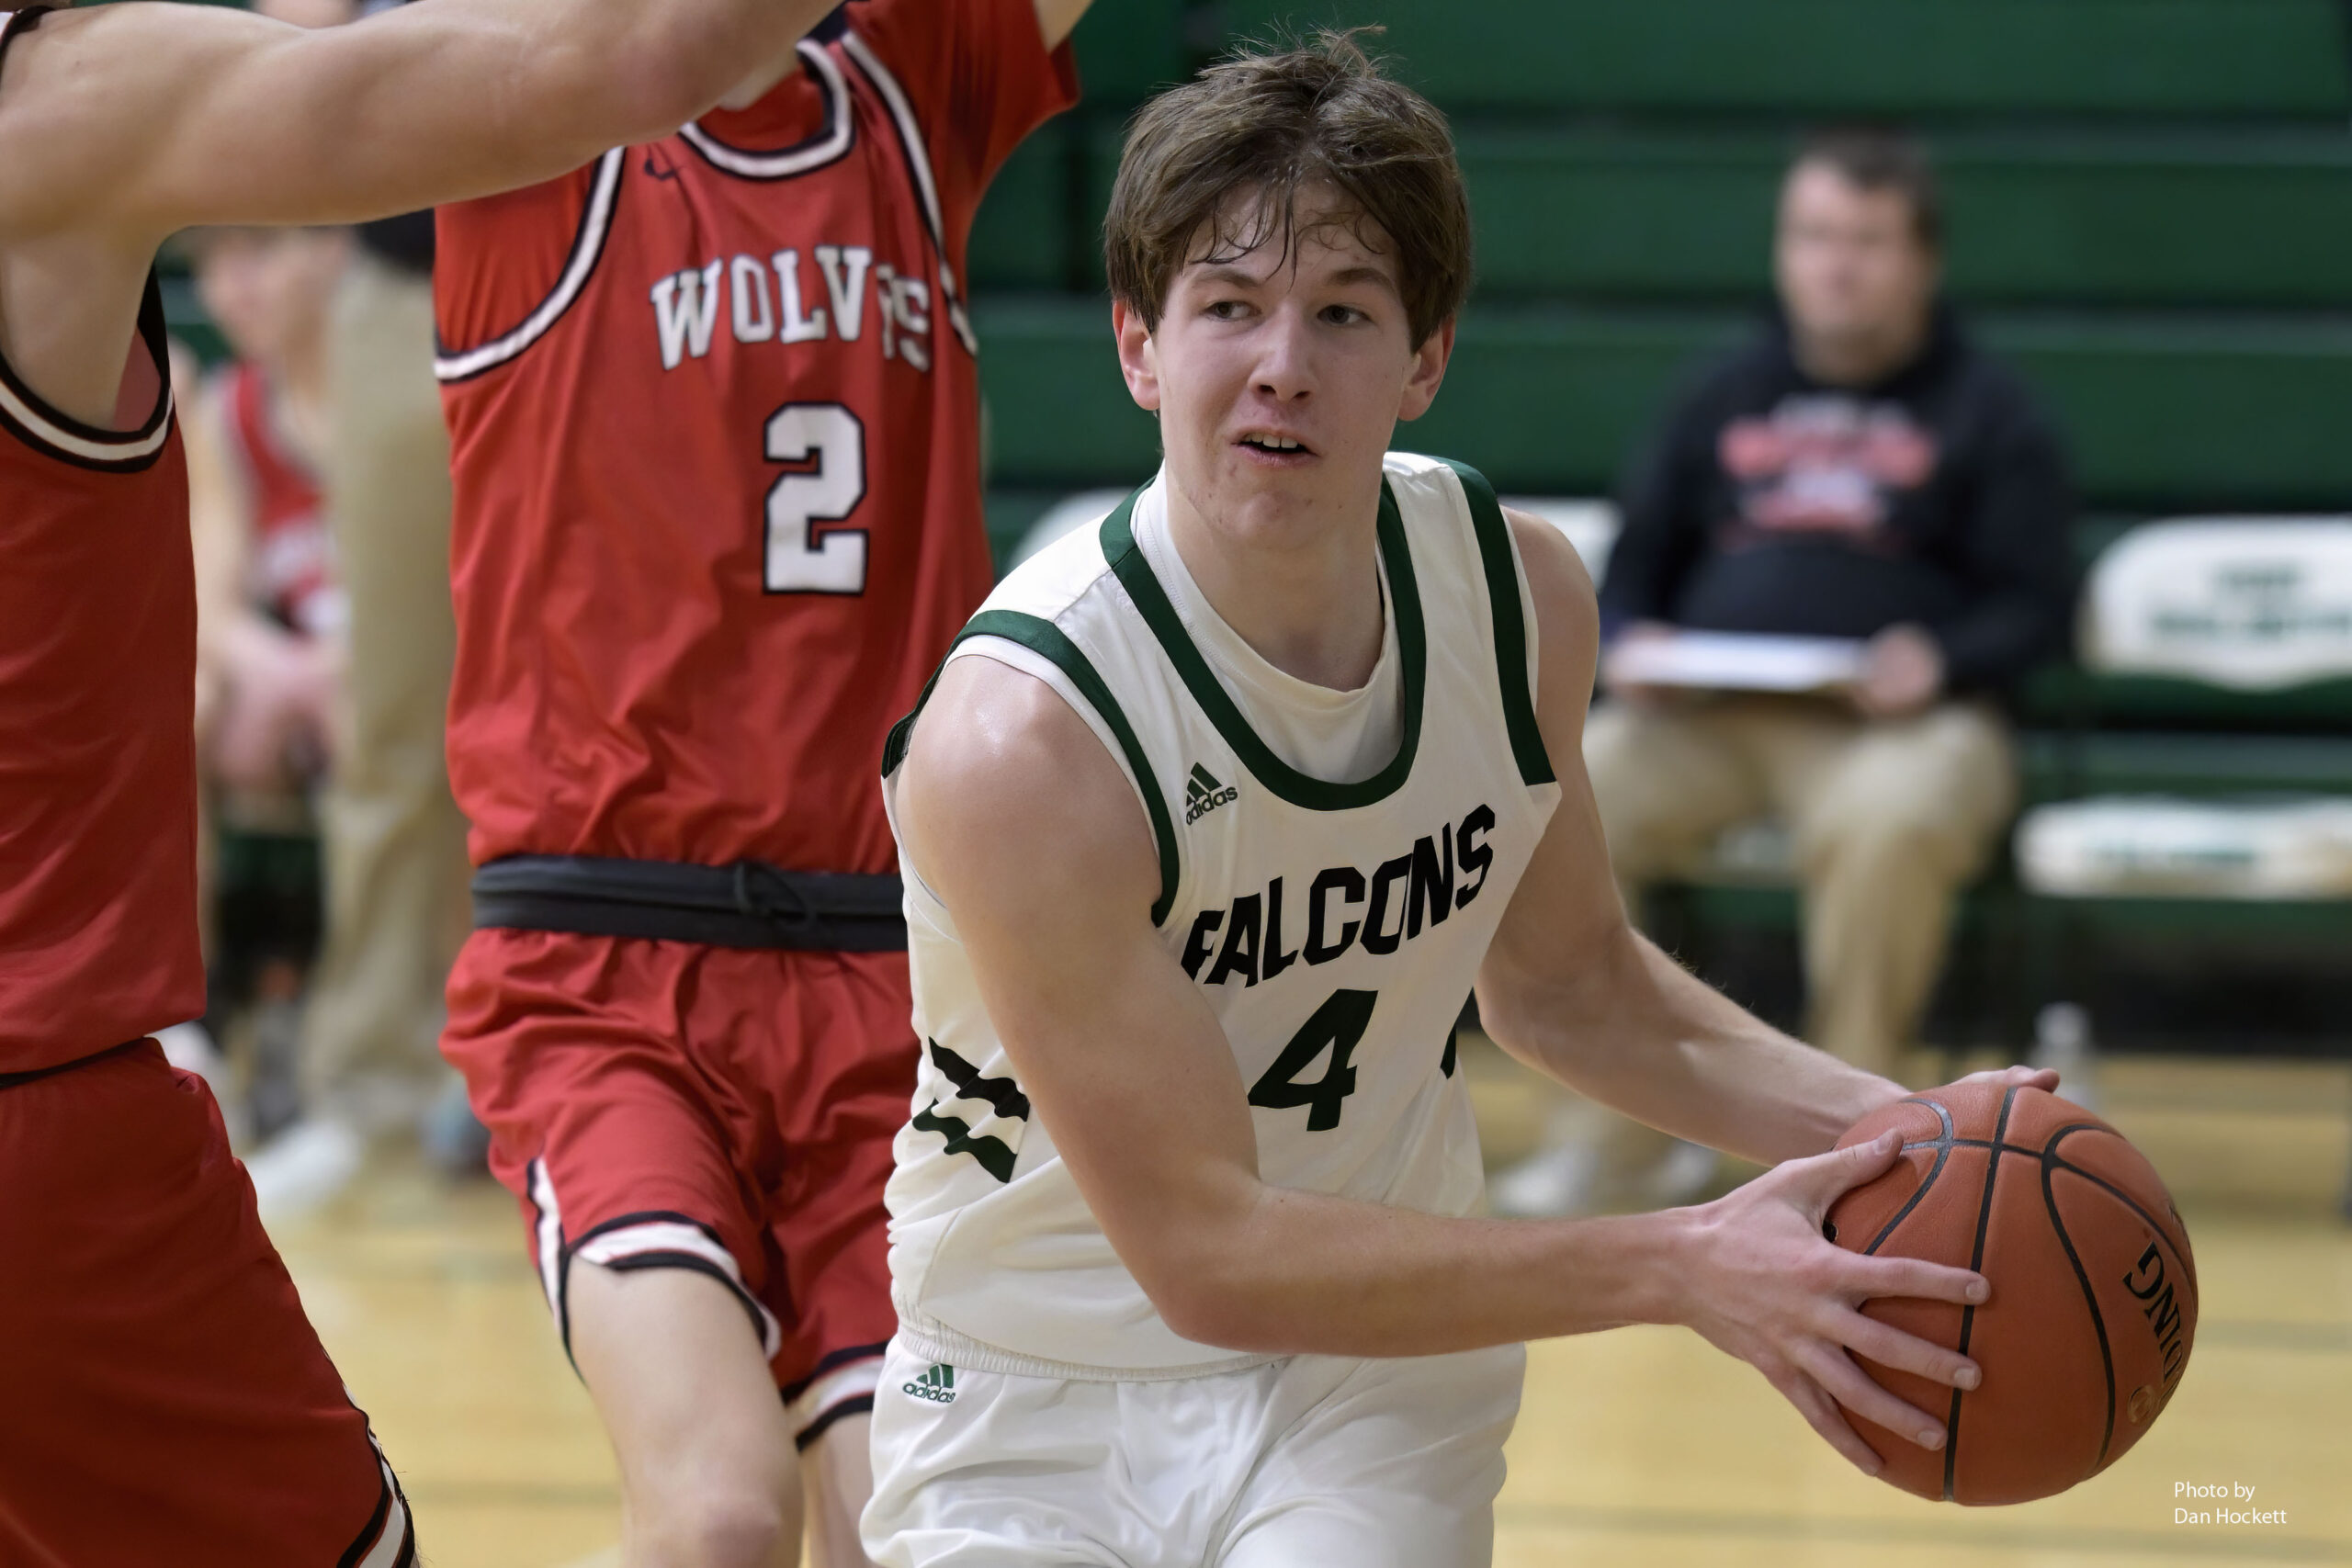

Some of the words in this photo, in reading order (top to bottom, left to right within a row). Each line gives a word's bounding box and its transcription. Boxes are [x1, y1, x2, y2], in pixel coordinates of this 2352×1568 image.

[763, 401, 868, 595] 2
[1186, 787, 1238, 826] adidas
[1180, 803, 1496, 988] FALCONS
[1247, 988, 1379, 1132] 4
[902, 1382, 956, 1404] adidas
